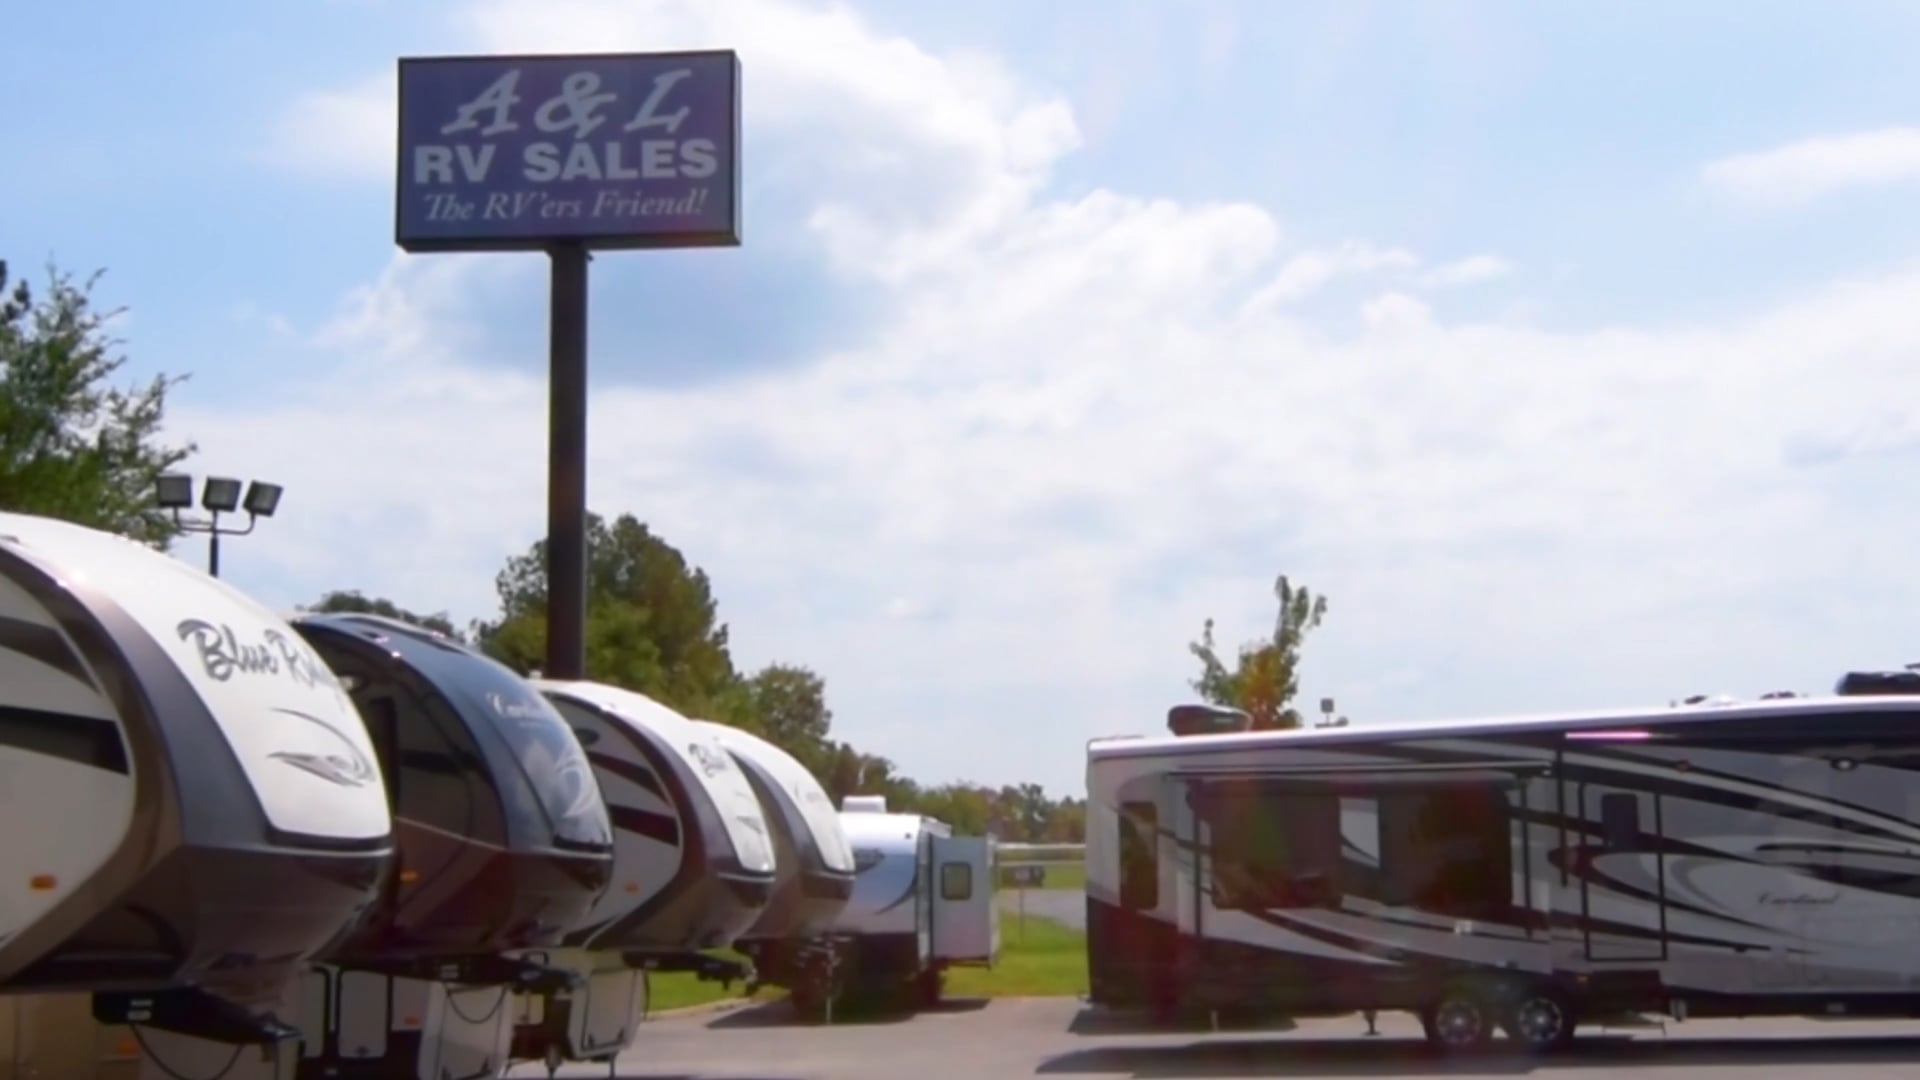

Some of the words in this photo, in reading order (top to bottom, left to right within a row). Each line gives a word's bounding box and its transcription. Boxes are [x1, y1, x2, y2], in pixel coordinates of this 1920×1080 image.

[440, 69, 521, 136] A
[534, 71, 617, 139] &
[623, 69, 692, 132] L
[415, 145, 496, 184] RV
[523, 138, 718, 182] SALES
[424, 191, 474, 221] The
[482, 190, 582, 220] RV'ers
[592, 186, 709, 217] Friend!
[176, 618, 279, 682] Blue
